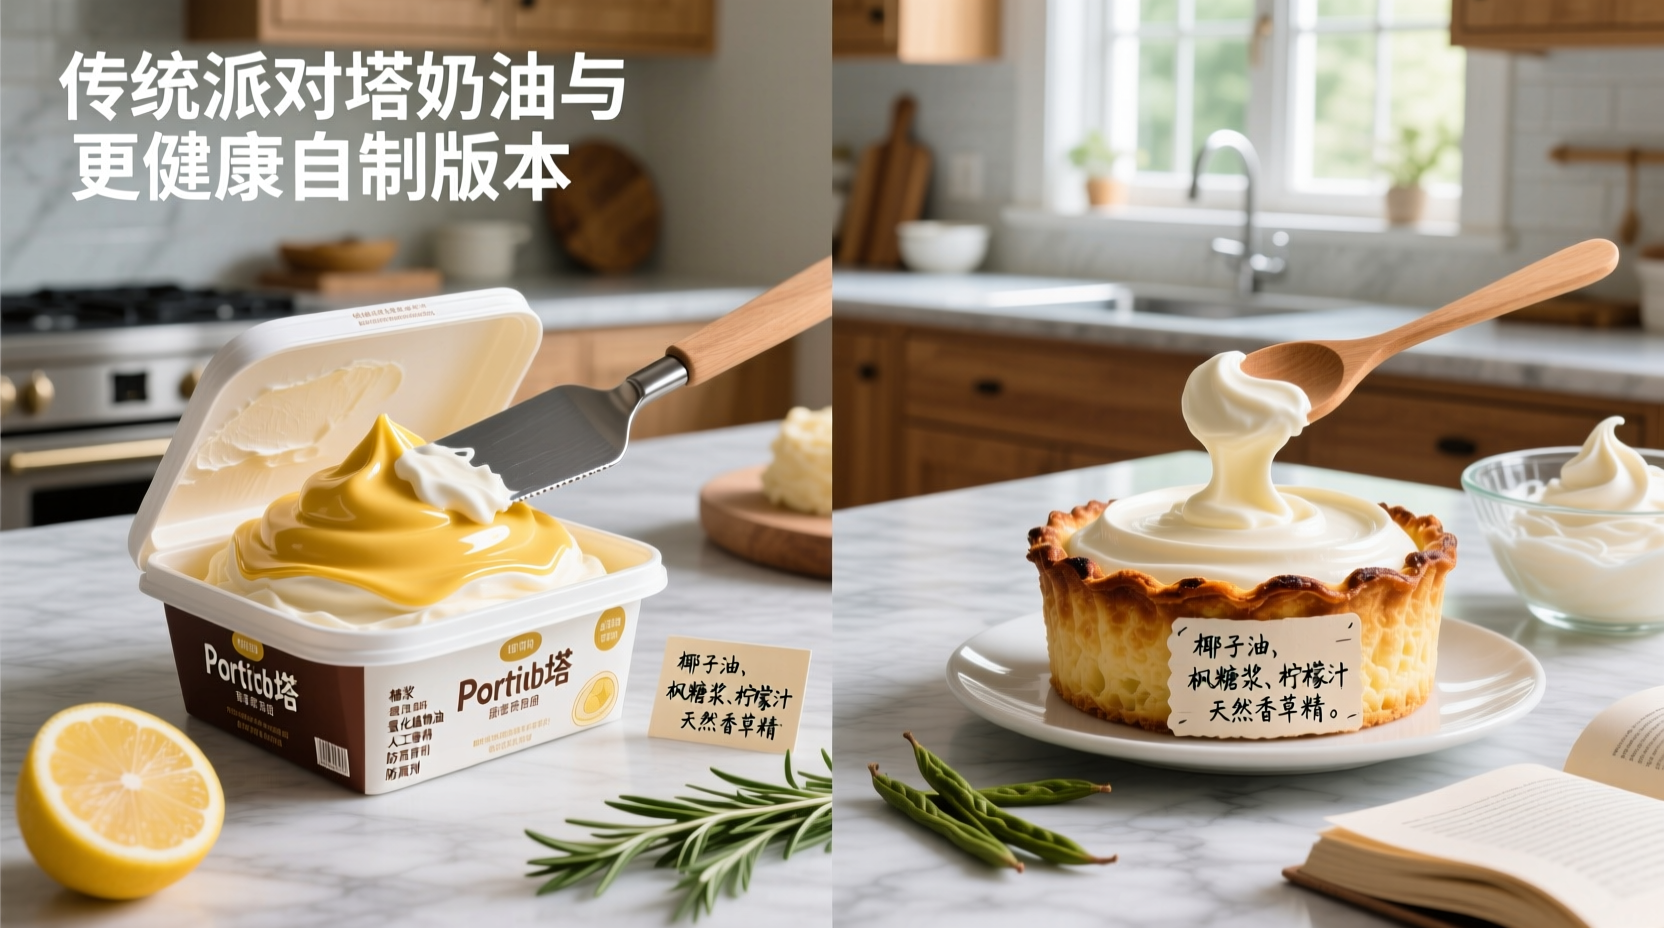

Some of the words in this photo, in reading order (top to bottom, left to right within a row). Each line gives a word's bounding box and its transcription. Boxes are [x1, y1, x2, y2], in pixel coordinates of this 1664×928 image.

[1209, 693, 1338, 724] 天然香草精。
